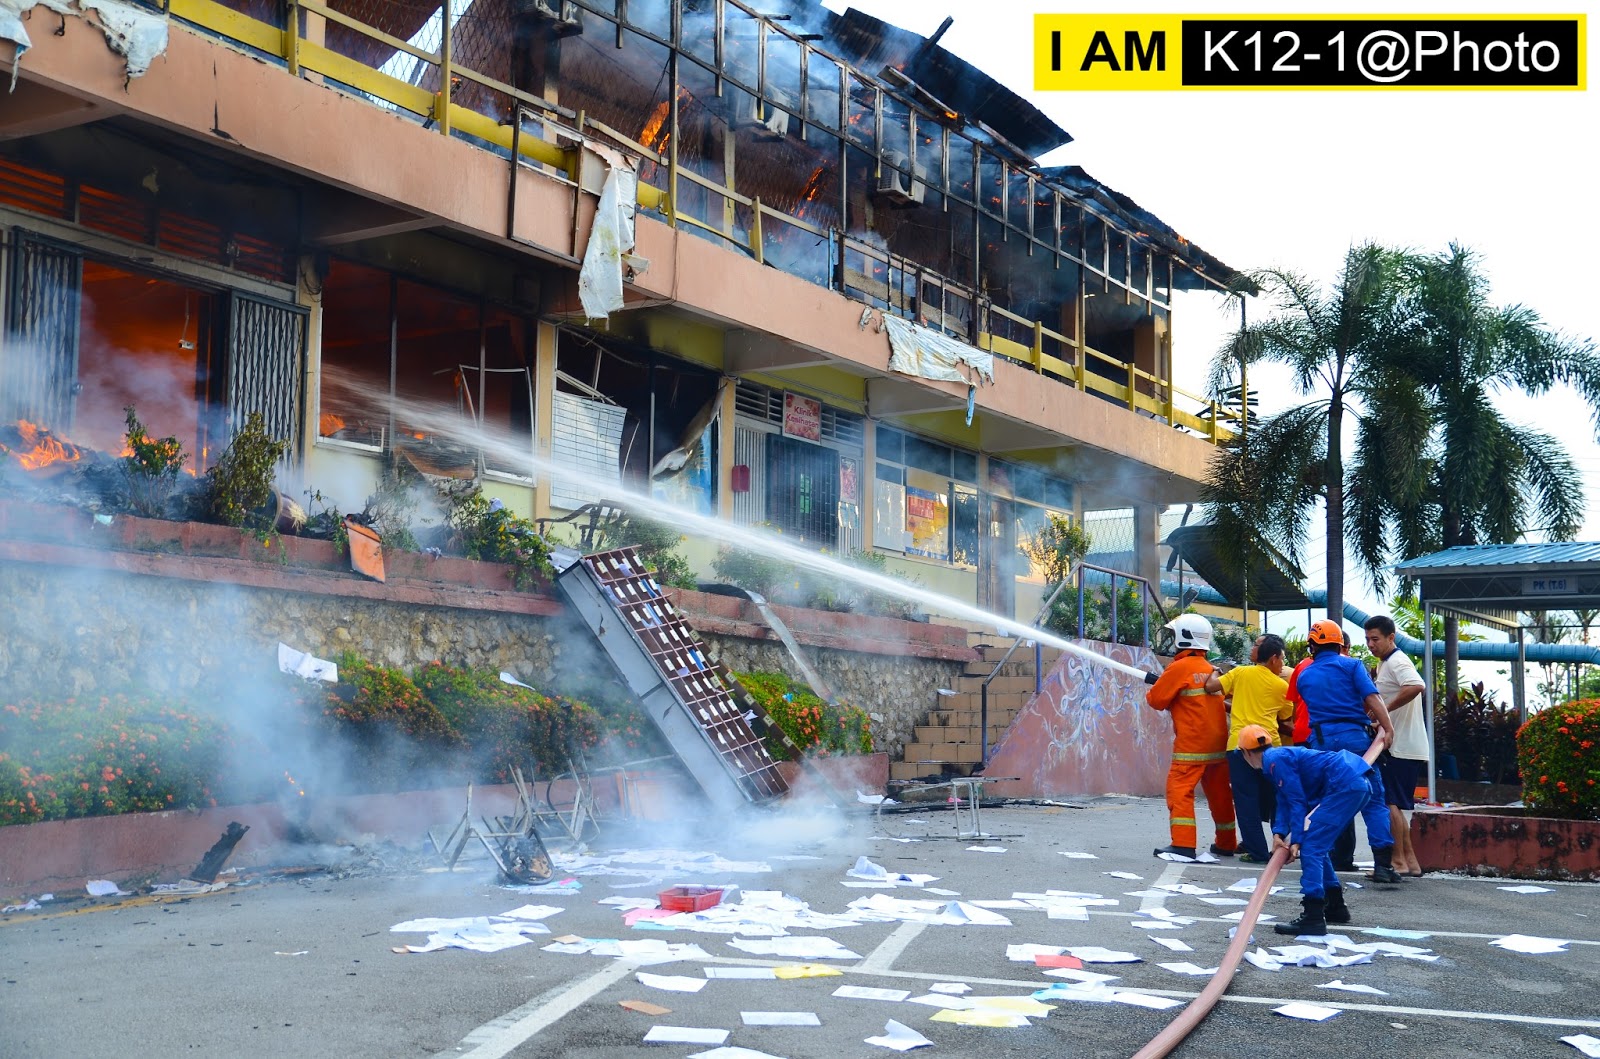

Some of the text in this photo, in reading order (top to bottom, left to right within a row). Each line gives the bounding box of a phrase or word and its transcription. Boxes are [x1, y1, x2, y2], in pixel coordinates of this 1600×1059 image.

[794, 405, 813, 417] Klinik
[786, 412, 819, 428] Kesihatan
[1533, 580, 1545, 590] PK
